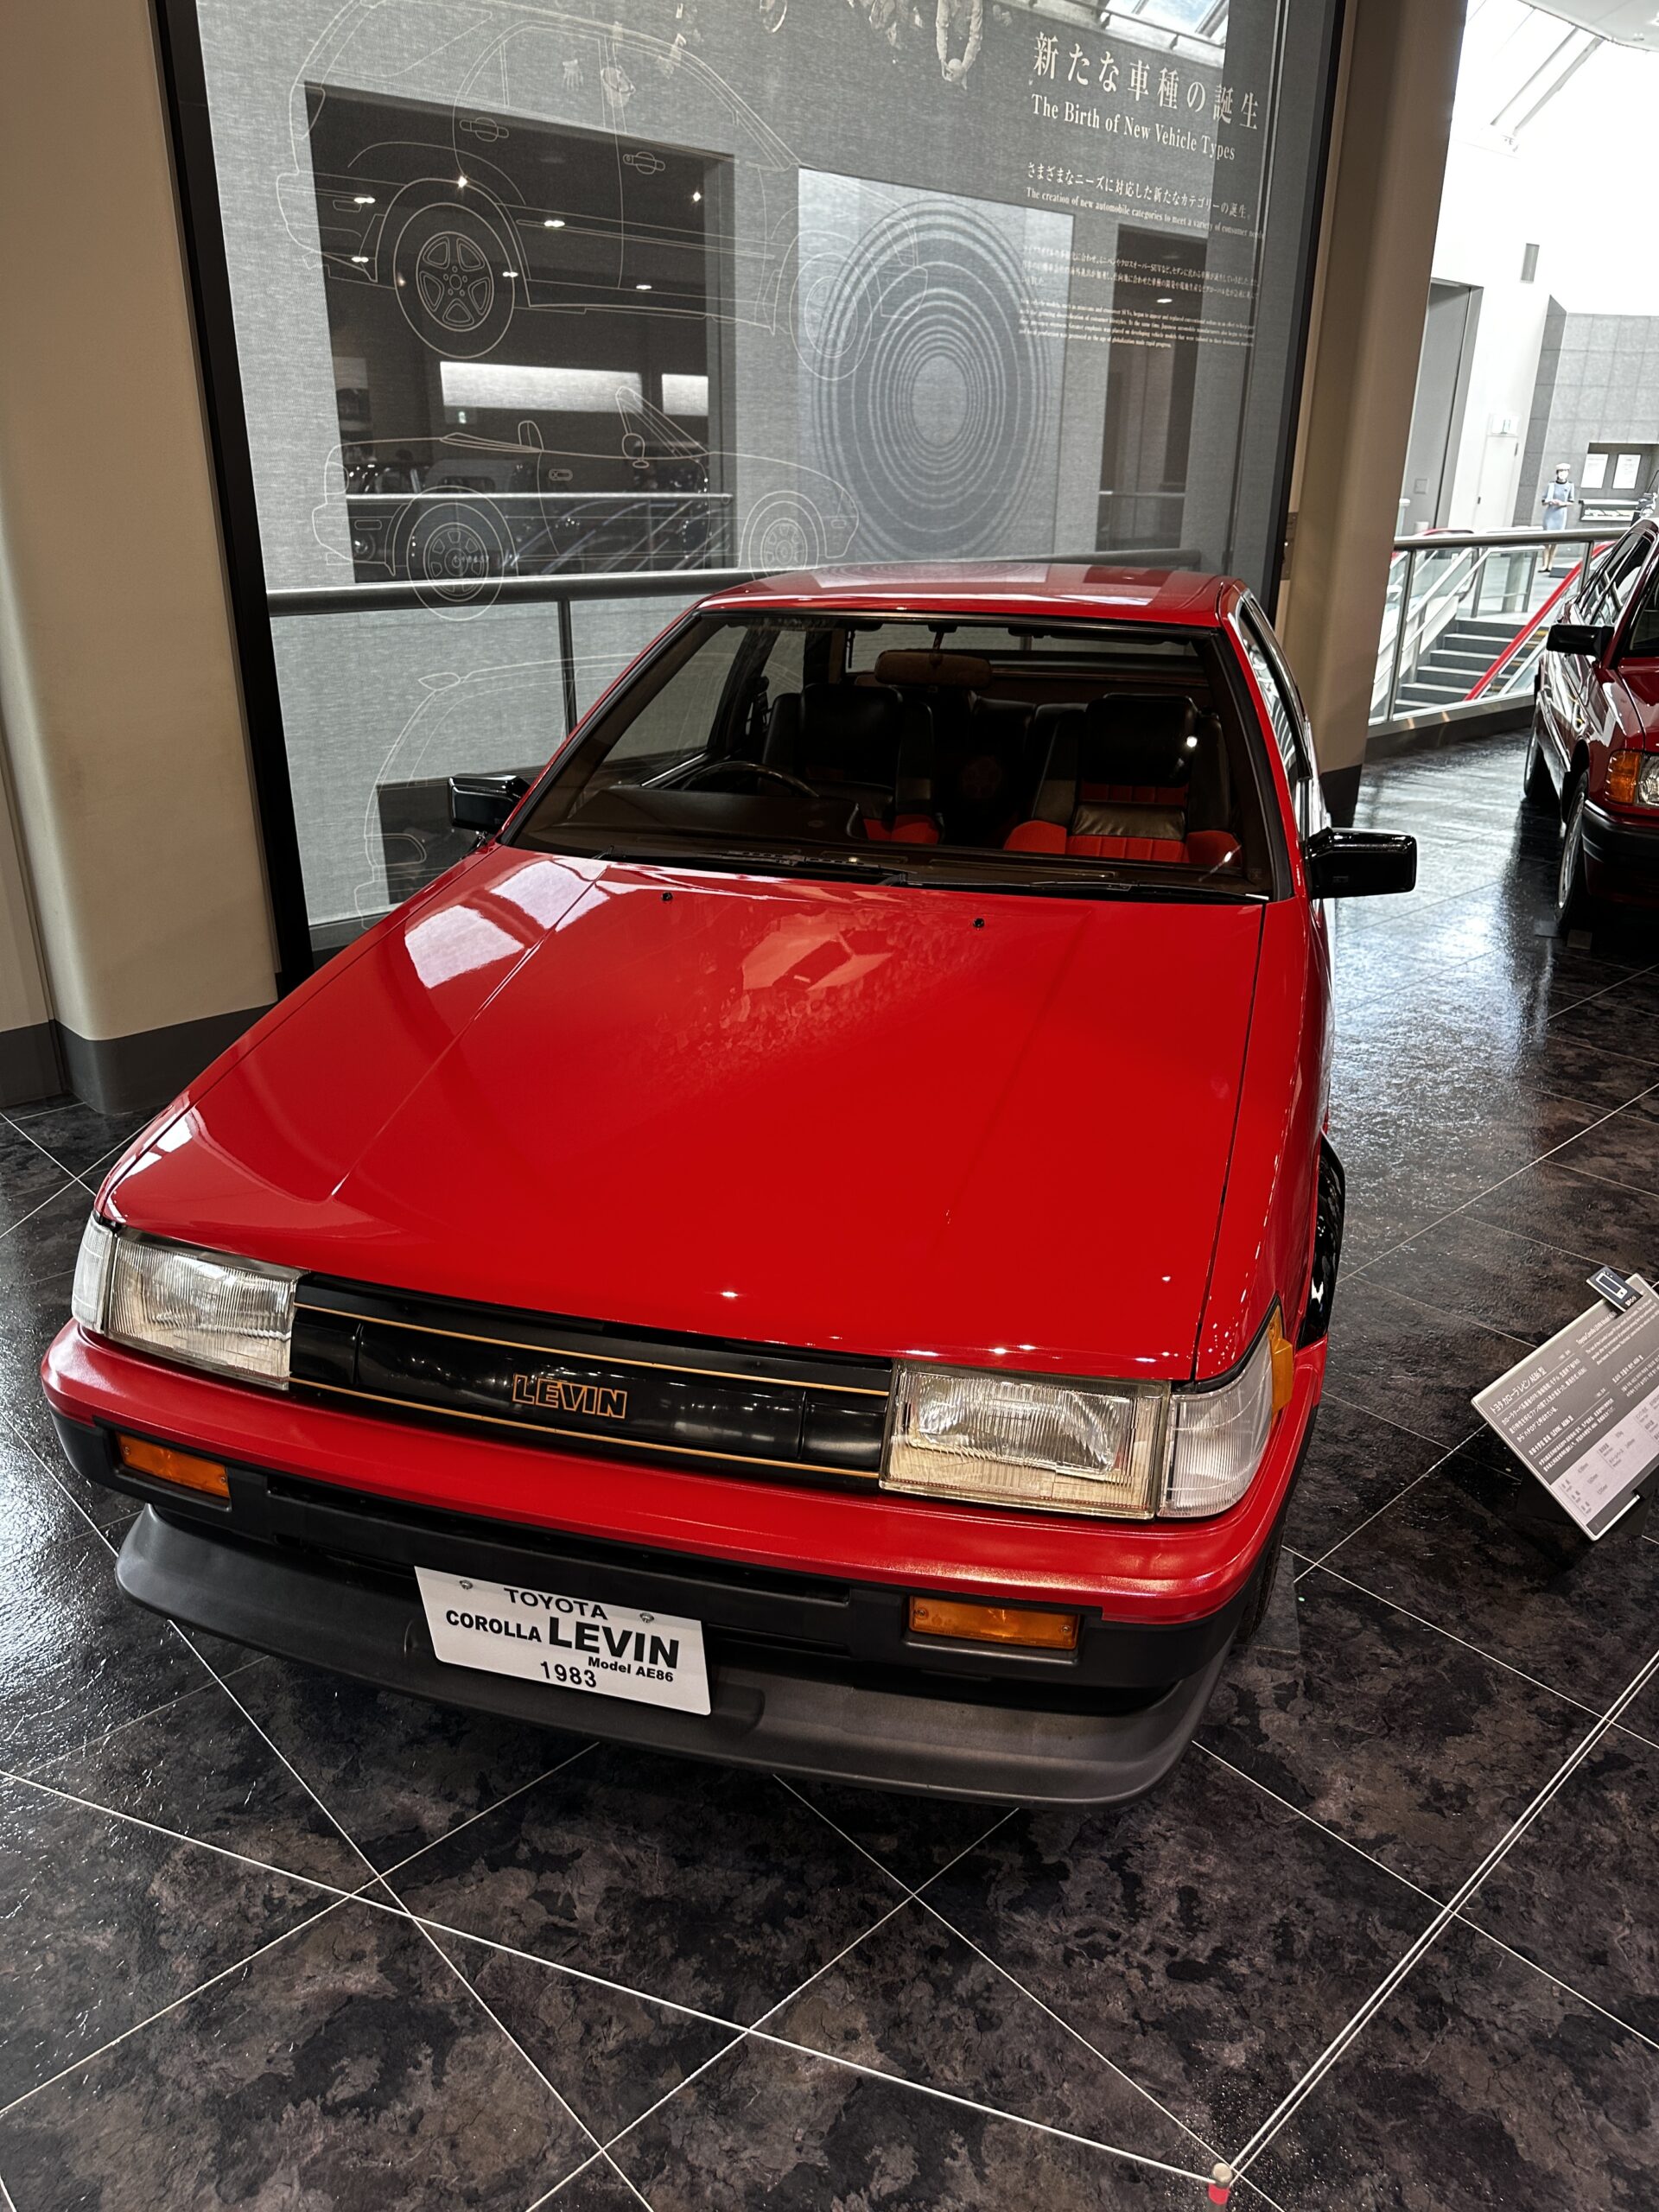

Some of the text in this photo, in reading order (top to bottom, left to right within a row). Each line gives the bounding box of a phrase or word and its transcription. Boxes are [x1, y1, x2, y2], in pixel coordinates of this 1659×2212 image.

[1033, 31, 1259, 129] 新たな車種の誕生
[1031, 93, 1236, 161] The Birth of New Vehicle Types
[1026, 186, 1039, 200] The
[1041, 192, 1070, 204] creation
[1071, 195, 1079, 207] of
[1080, 199, 1093, 208] new
[1095, 202, 1130, 215] automobile
[1131, 209, 1163, 220] categories
[512, 1373, 628, 1419] LEVIN
[1490, 1401, 1503, 1414] トヨタ
[1502, 1388, 1520, 1406] カローラ
[1516, 1379, 1530, 1392] レビン
[504, 1587, 608, 1620] TOYOTA
[445, 1610, 680, 1669] COROLLA LEVIN
[540, 1661, 597, 1688] 1983
[588, 1656, 674, 1682] Model AE86
